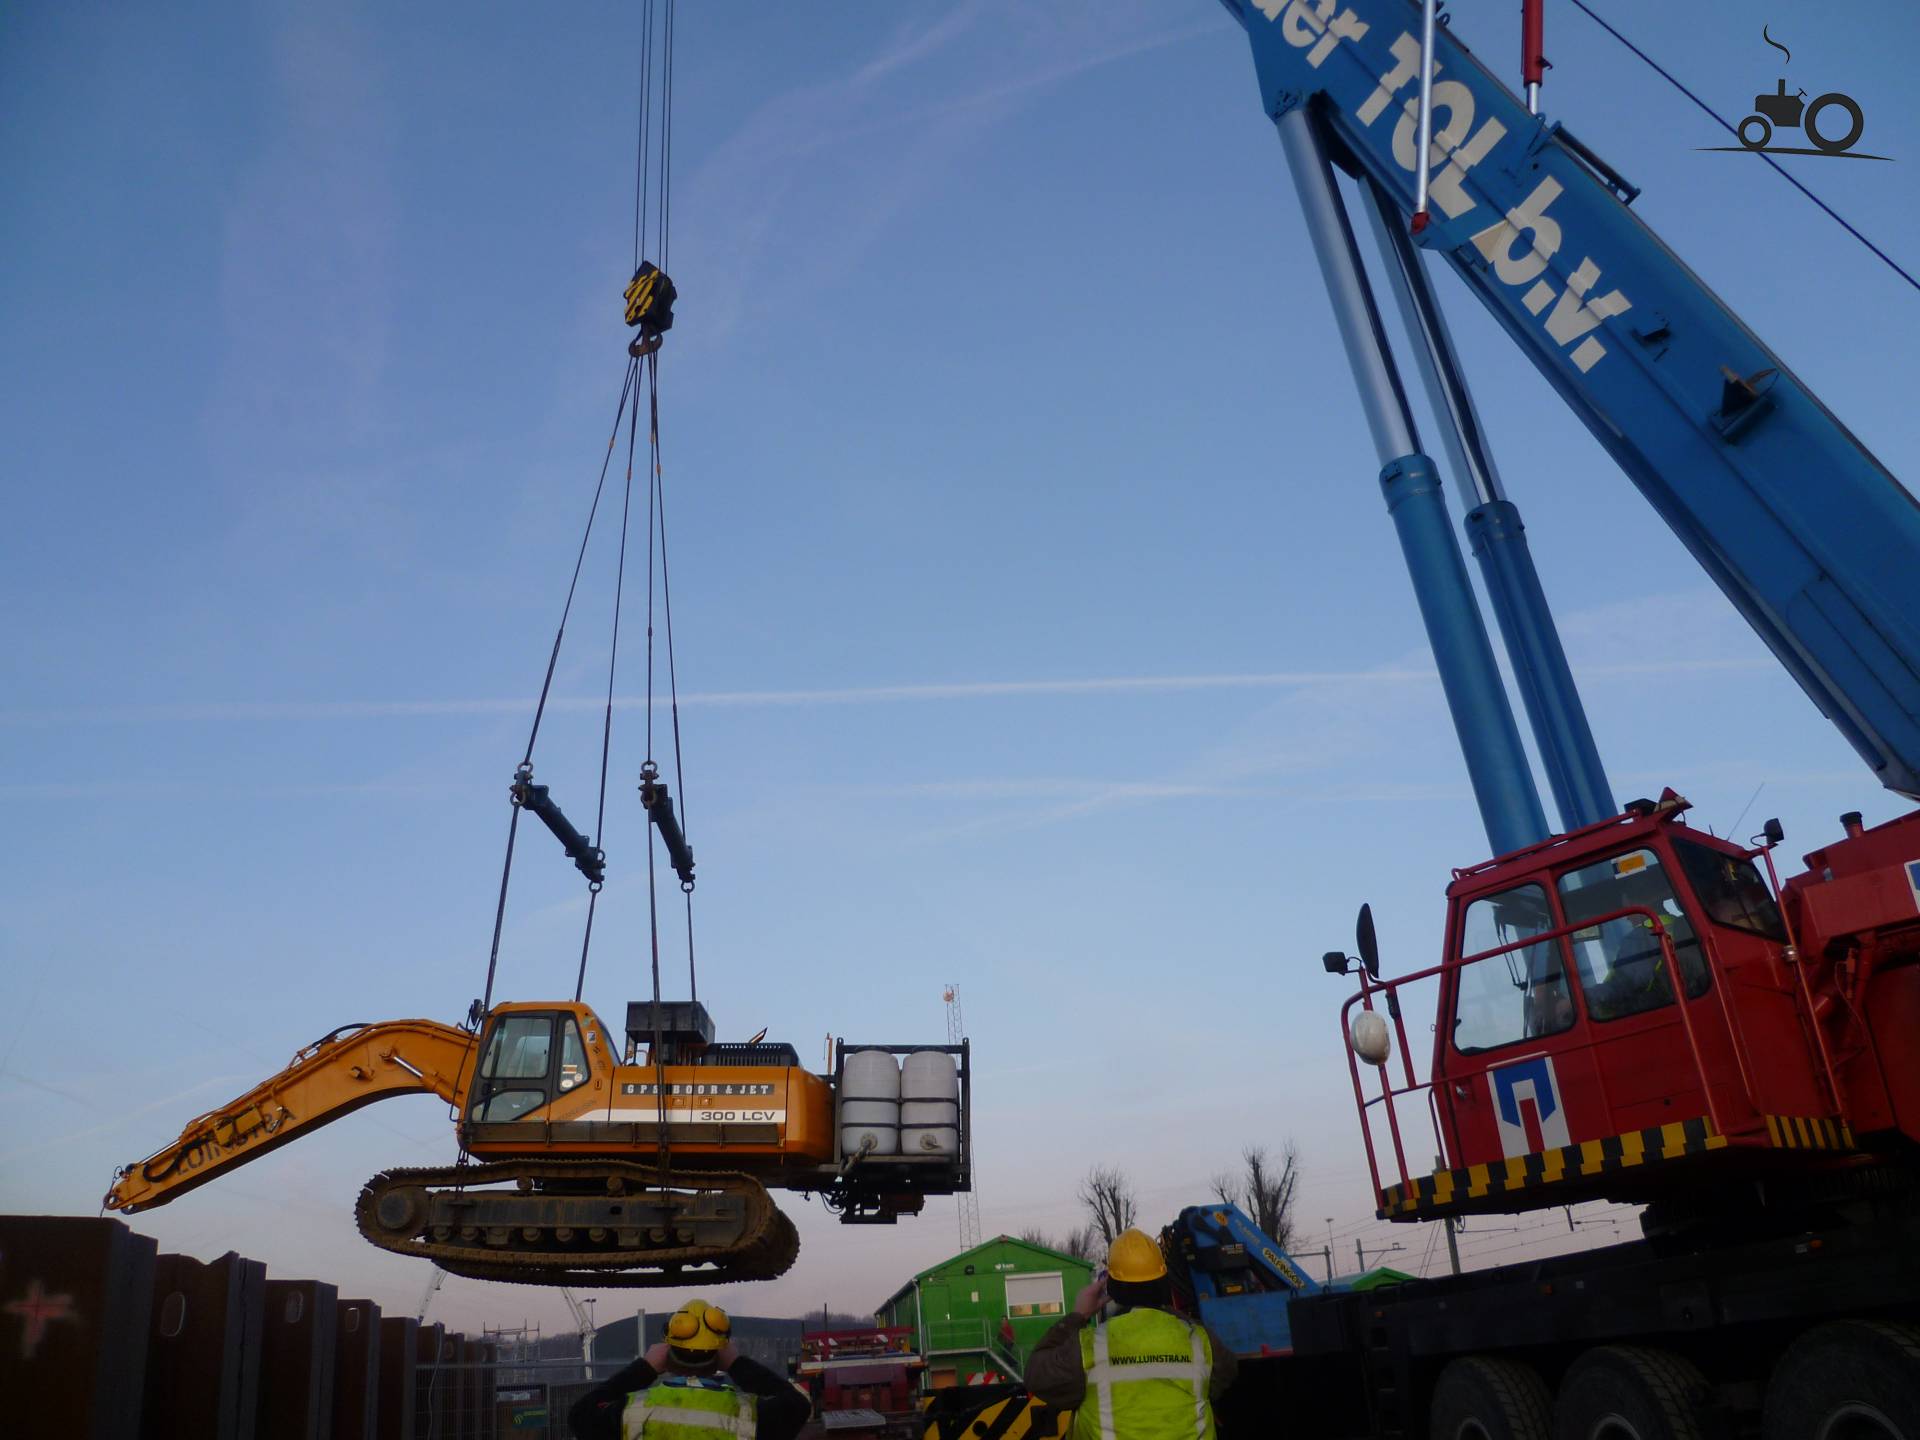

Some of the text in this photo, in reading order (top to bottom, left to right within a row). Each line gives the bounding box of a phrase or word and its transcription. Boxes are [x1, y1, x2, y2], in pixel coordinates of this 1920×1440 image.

[627, 1084, 659, 1095] GPS
[701, 1111, 776, 1121] 300 LCV
[1111, 1353, 1192, 1366] WWW.LUINSTRA.NL
